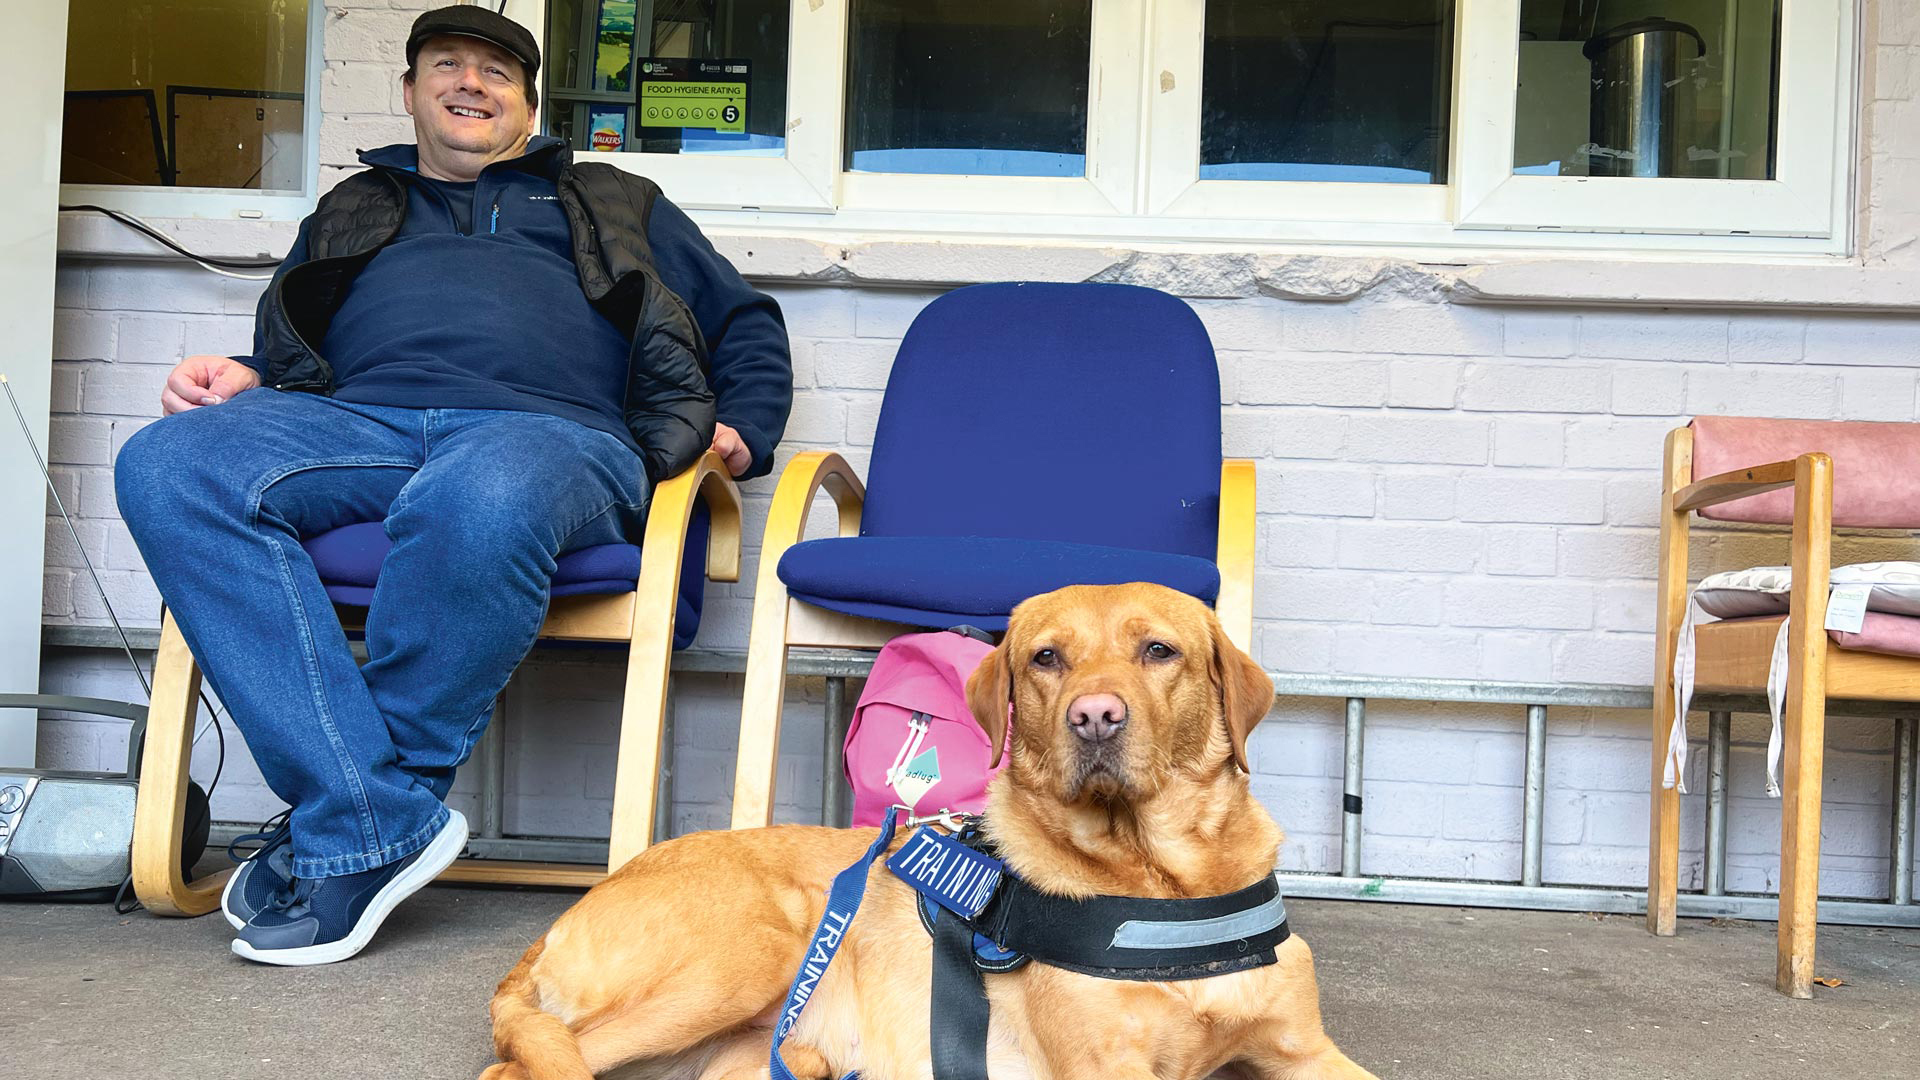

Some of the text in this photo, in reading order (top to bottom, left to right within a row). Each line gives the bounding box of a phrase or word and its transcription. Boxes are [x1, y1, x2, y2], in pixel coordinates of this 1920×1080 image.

[647, 85, 741, 95] FOOD HYGIENE RATING
[725, 107, 735, 121] 5
[593, 135, 621, 145] WALKERS
[905, 770, 933, 784] adlug
[899, 833, 1000, 912] TRAINING
[779, 911, 851, 1037] TRAINING
